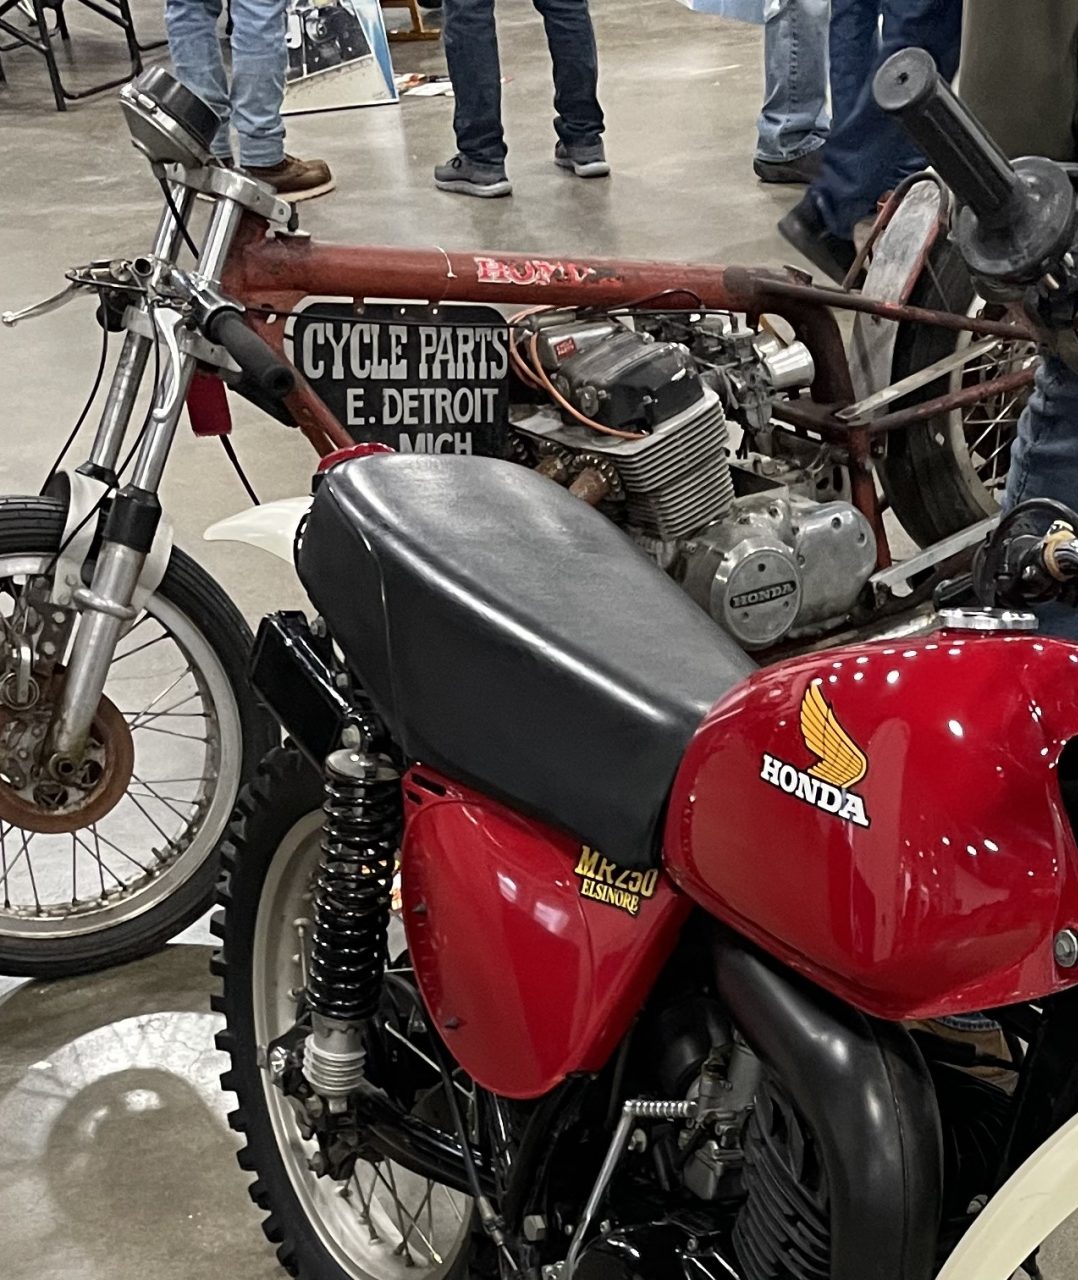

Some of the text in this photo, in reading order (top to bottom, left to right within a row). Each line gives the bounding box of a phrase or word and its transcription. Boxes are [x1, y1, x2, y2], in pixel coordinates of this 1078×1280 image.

[303, 325, 508, 380] CYCLE PARTS
[347, 389, 499, 425] E. DETROIT
[399, 432, 473, 455] MICH
[732, 583, 793, 606] HONDA
[761, 754, 869, 826] HONDA
[580, 878, 639, 914] ELSINORE
